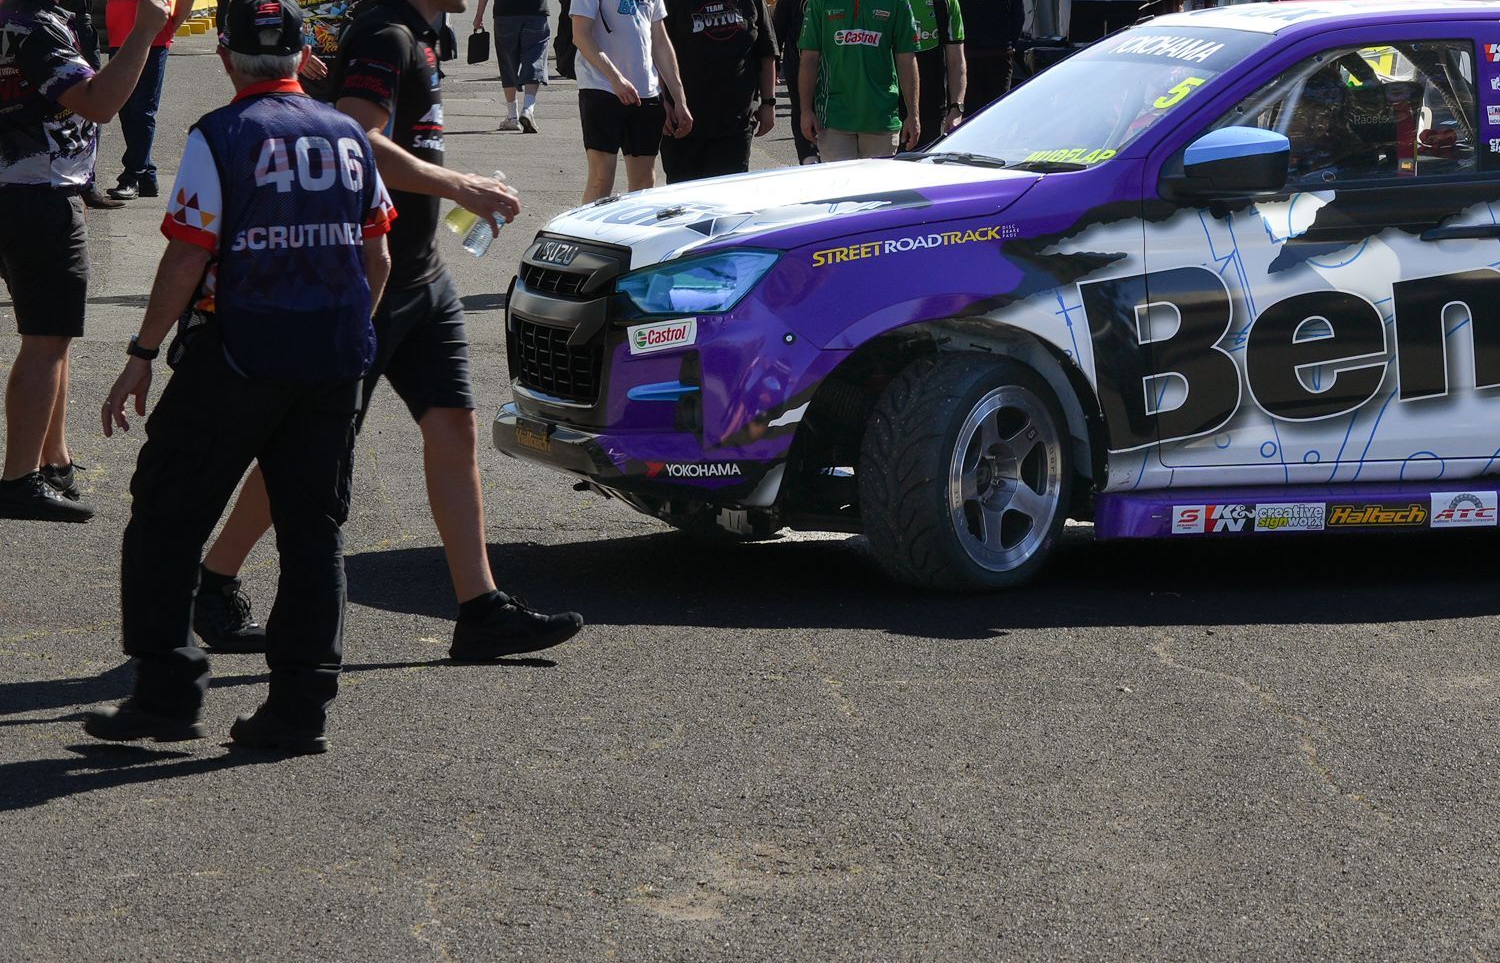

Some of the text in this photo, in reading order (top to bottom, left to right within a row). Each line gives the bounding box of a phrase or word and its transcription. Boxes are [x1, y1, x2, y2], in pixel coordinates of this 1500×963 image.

[705, 3, 724, 13] TEAM
[691, 9, 745, 34] BUTTON
[844, 30, 879, 45] Castrol
[1109, 34, 1225, 63] YOKOHAMA
[1153, 76, 1205, 110] 5
[254, 136, 364, 193] 406
[537, 239, 580, 264] ISUZU
[646, 324, 688, 347] Castrol
[666, 462, 742, 478] YOKOHAMA
[1256, 505, 1324, 518] creative
[1328, 505, 1426, 525] Haltech
[1433, 507, 1497, 520] ATC
